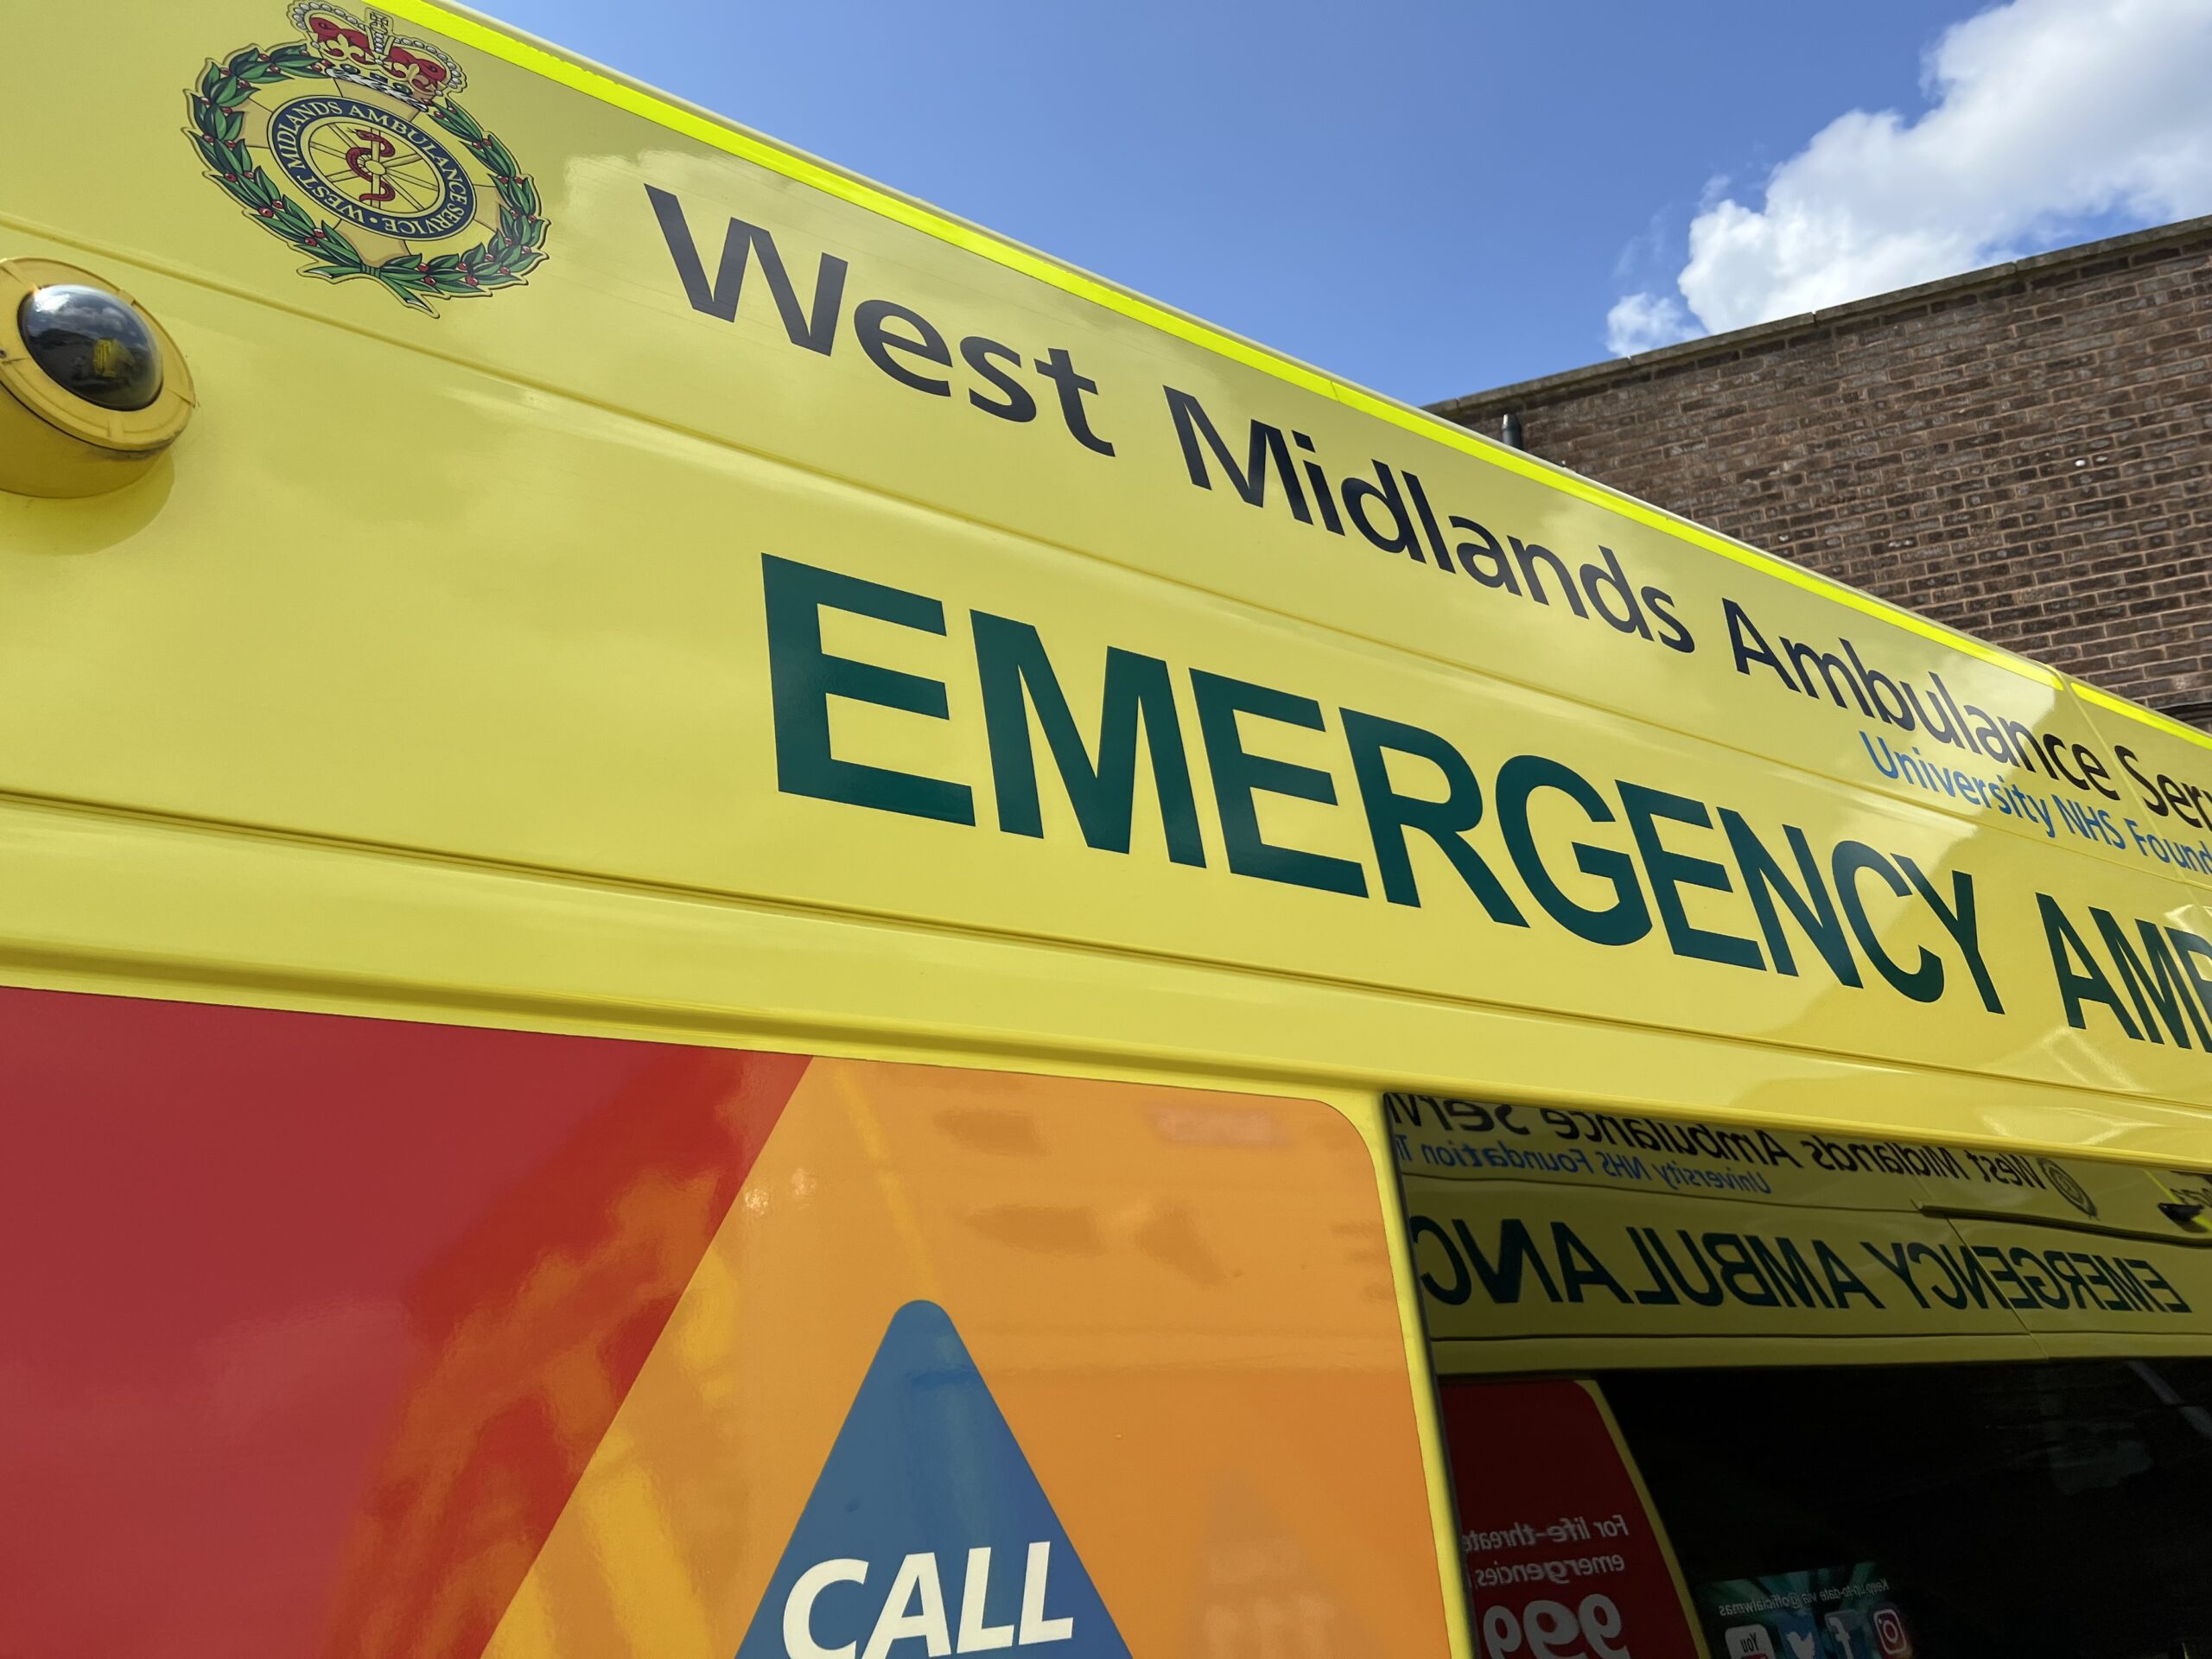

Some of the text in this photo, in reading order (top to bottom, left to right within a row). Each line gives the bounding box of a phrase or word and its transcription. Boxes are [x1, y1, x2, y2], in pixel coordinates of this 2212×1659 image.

[277, 101, 467, 234] WEST MIDLANDS AMBULANCE SERVICE
[644, 183, 1116, 457] West
[1164, 384, 1694, 653] Midlands
[1722, 598, 2119, 801] Ambulance
[760, 552, 2005, 1015] EMERGENCY
[1859, 731, 2056, 839] University
[2056, 794, 2126, 850] NHS
[782, 1541, 1074, 1659] CALL
